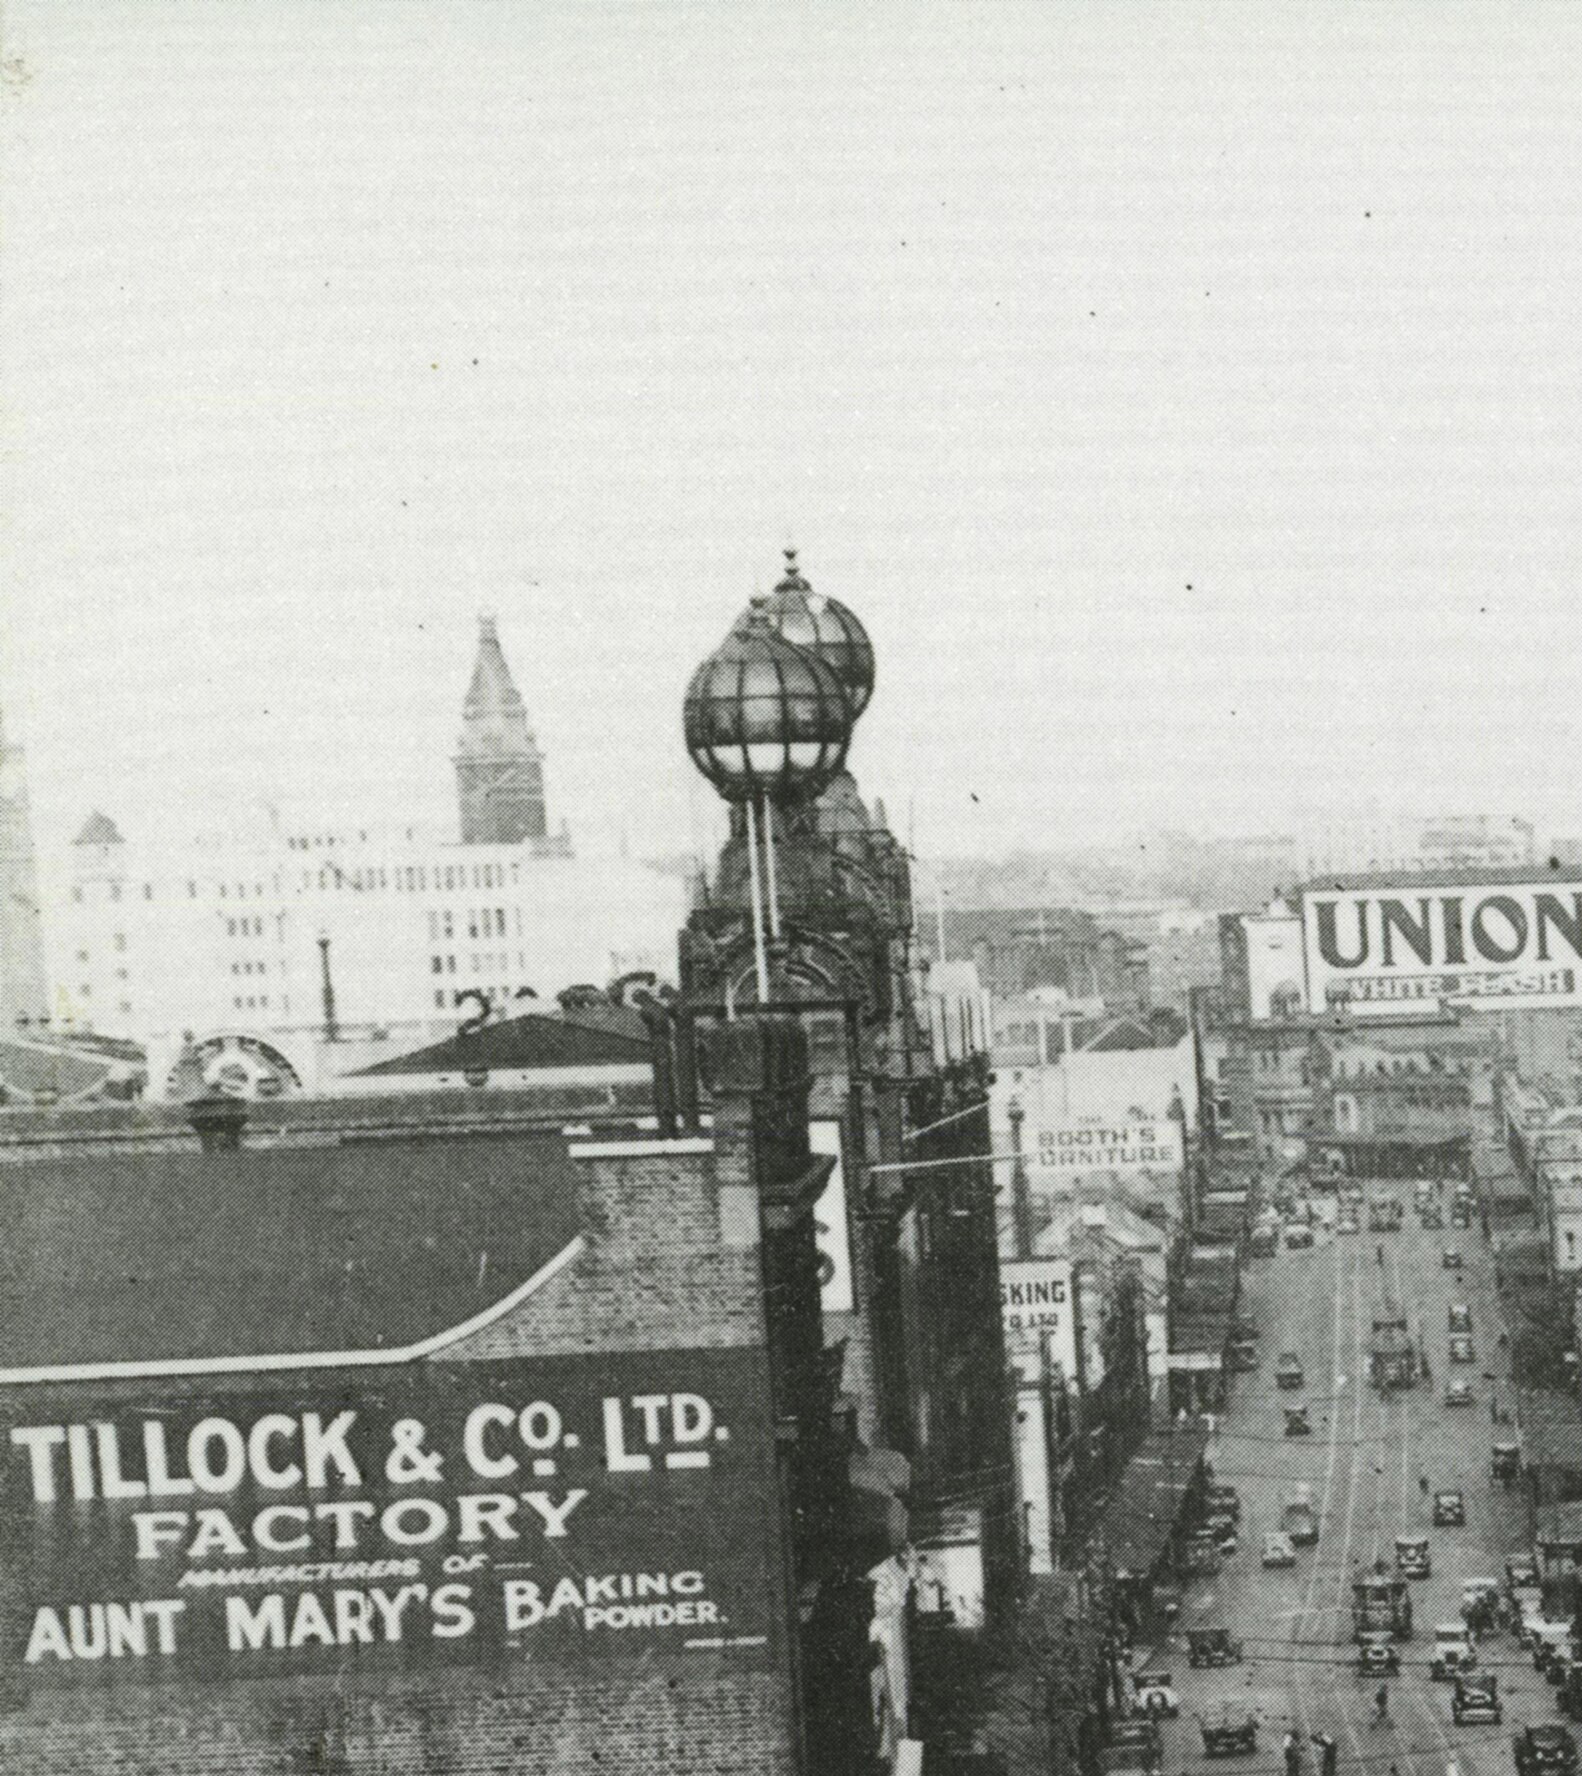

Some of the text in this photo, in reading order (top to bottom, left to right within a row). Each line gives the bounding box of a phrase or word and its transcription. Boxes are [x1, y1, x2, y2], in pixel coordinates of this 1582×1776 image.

[1037, 1145, 1174, 1168] URNITURE
[11, 1411, 363, 1501] TILLOCK
[385, 1418, 444, 1484] &
[131, 1489, 590, 1559] FACTORY
[177, 1555, 489, 1588] MANUFACTURERS OF
[24, 1600, 187, 1663] AUNT
[224, 1584, 477, 1652] MARY'S
